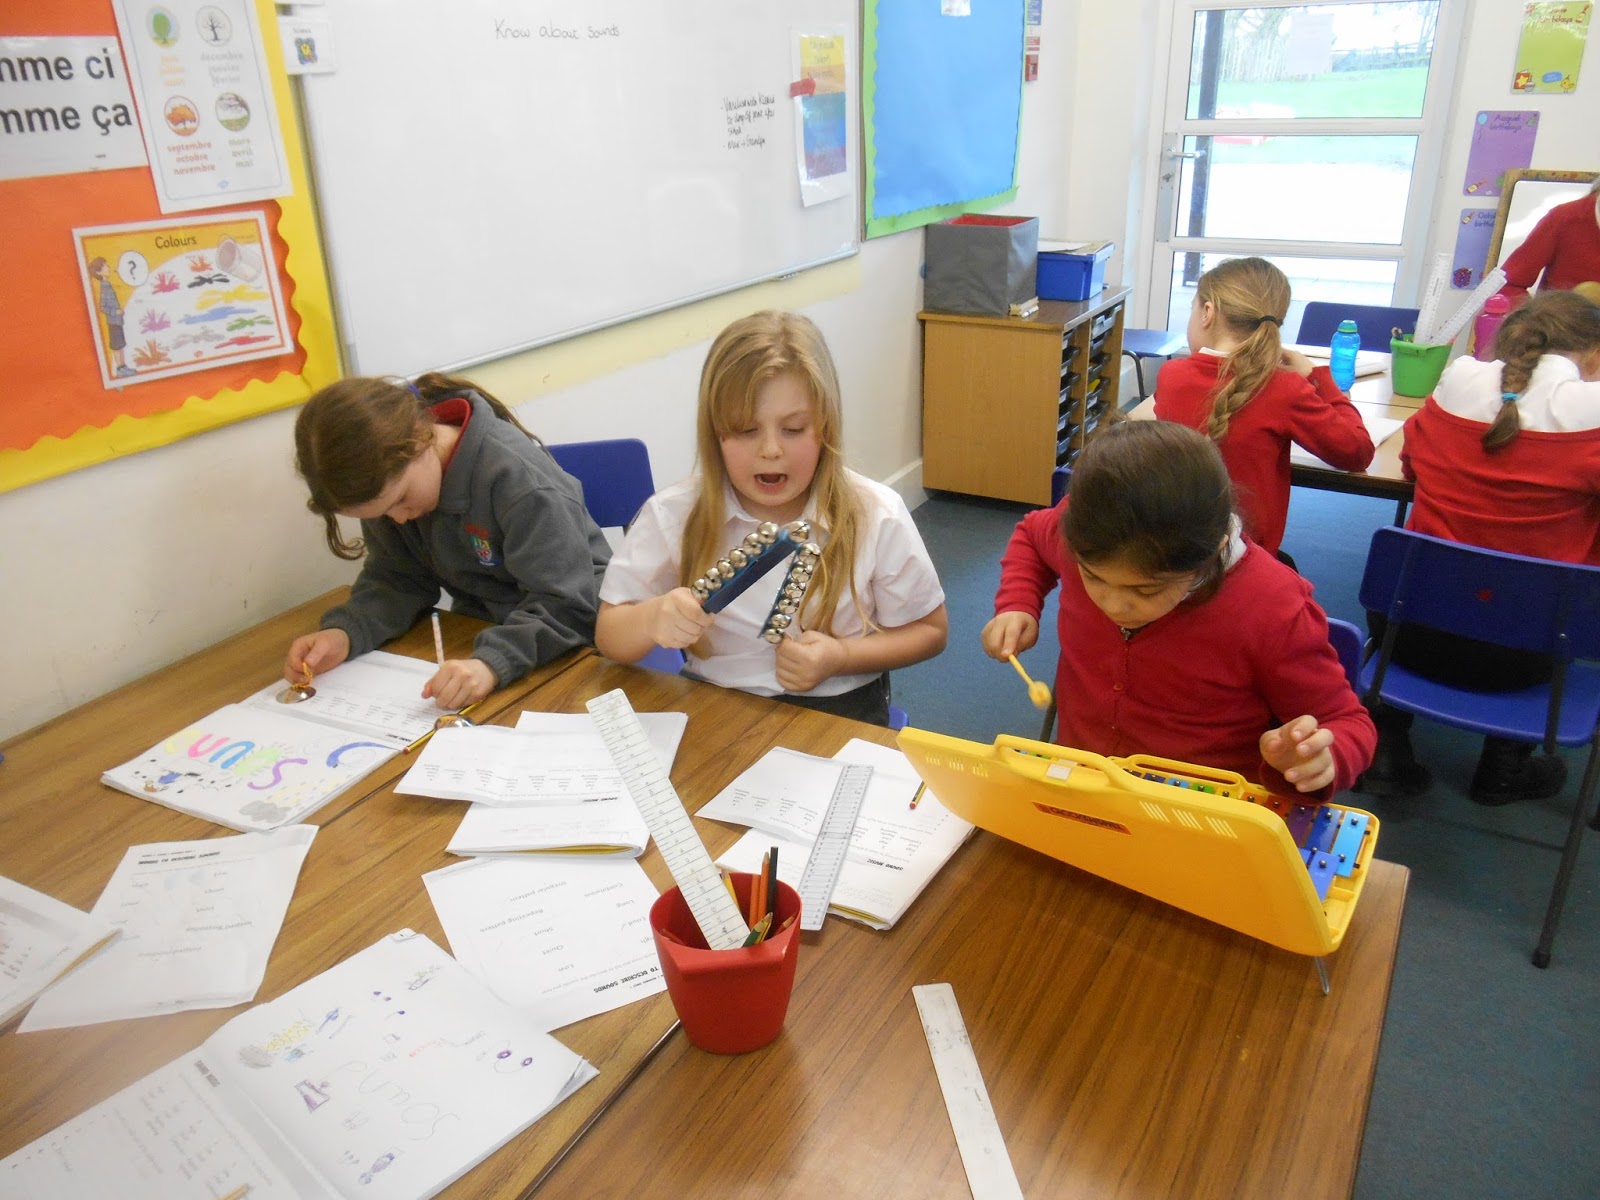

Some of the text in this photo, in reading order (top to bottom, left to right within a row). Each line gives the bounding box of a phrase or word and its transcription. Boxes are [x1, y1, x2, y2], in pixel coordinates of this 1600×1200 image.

[494, 18, 530, 40] Know
[539, 18, 579, 40] about
[85, 47, 115, 79] ci
[92, 103, 132, 136] ça
[167, 140, 212, 155] septembre
[176, 153, 209, 164] octobre
[174, 163, 216, 176] novembre
[154, 235, 198, 250] Colours
[127, 259, 138, 280] ?
[584, 882, 624, 898] Continuous
[616, 899, 635, 908] Long
[508, 908, 544, 924] Repeating
[628, 916, 646, 926] Loud
[534, 926, 554, 936] Short
[640, 936, 655, 944] igh
[542, 944, 564, 956] Quiet
[558, 963, 574, 972] Low
[622, 970, 648, 984] DESCRIBE
[594, 982, 618, 993] SOUNDS
